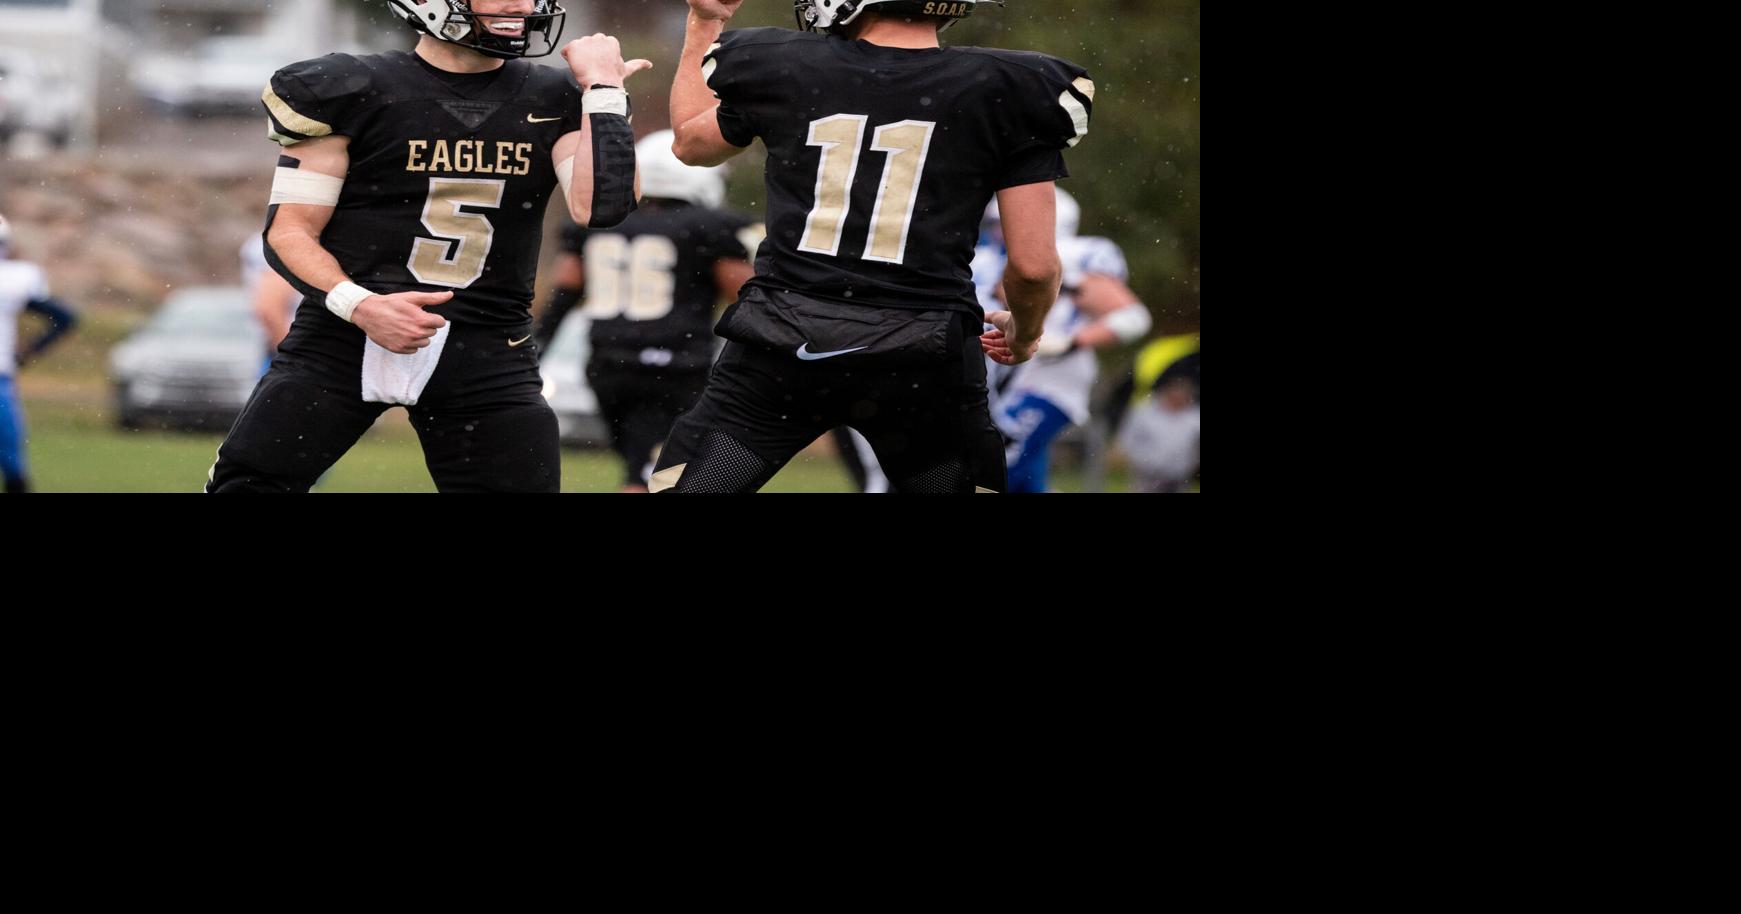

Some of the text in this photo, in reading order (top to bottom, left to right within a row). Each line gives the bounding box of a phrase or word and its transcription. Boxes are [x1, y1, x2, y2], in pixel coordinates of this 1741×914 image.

[406, 139, 532, 175] EAGLES
[797, 113, 936, 265] 11
[407, 177, 506, 289] 5
[584, 233, 678, 320] 66
